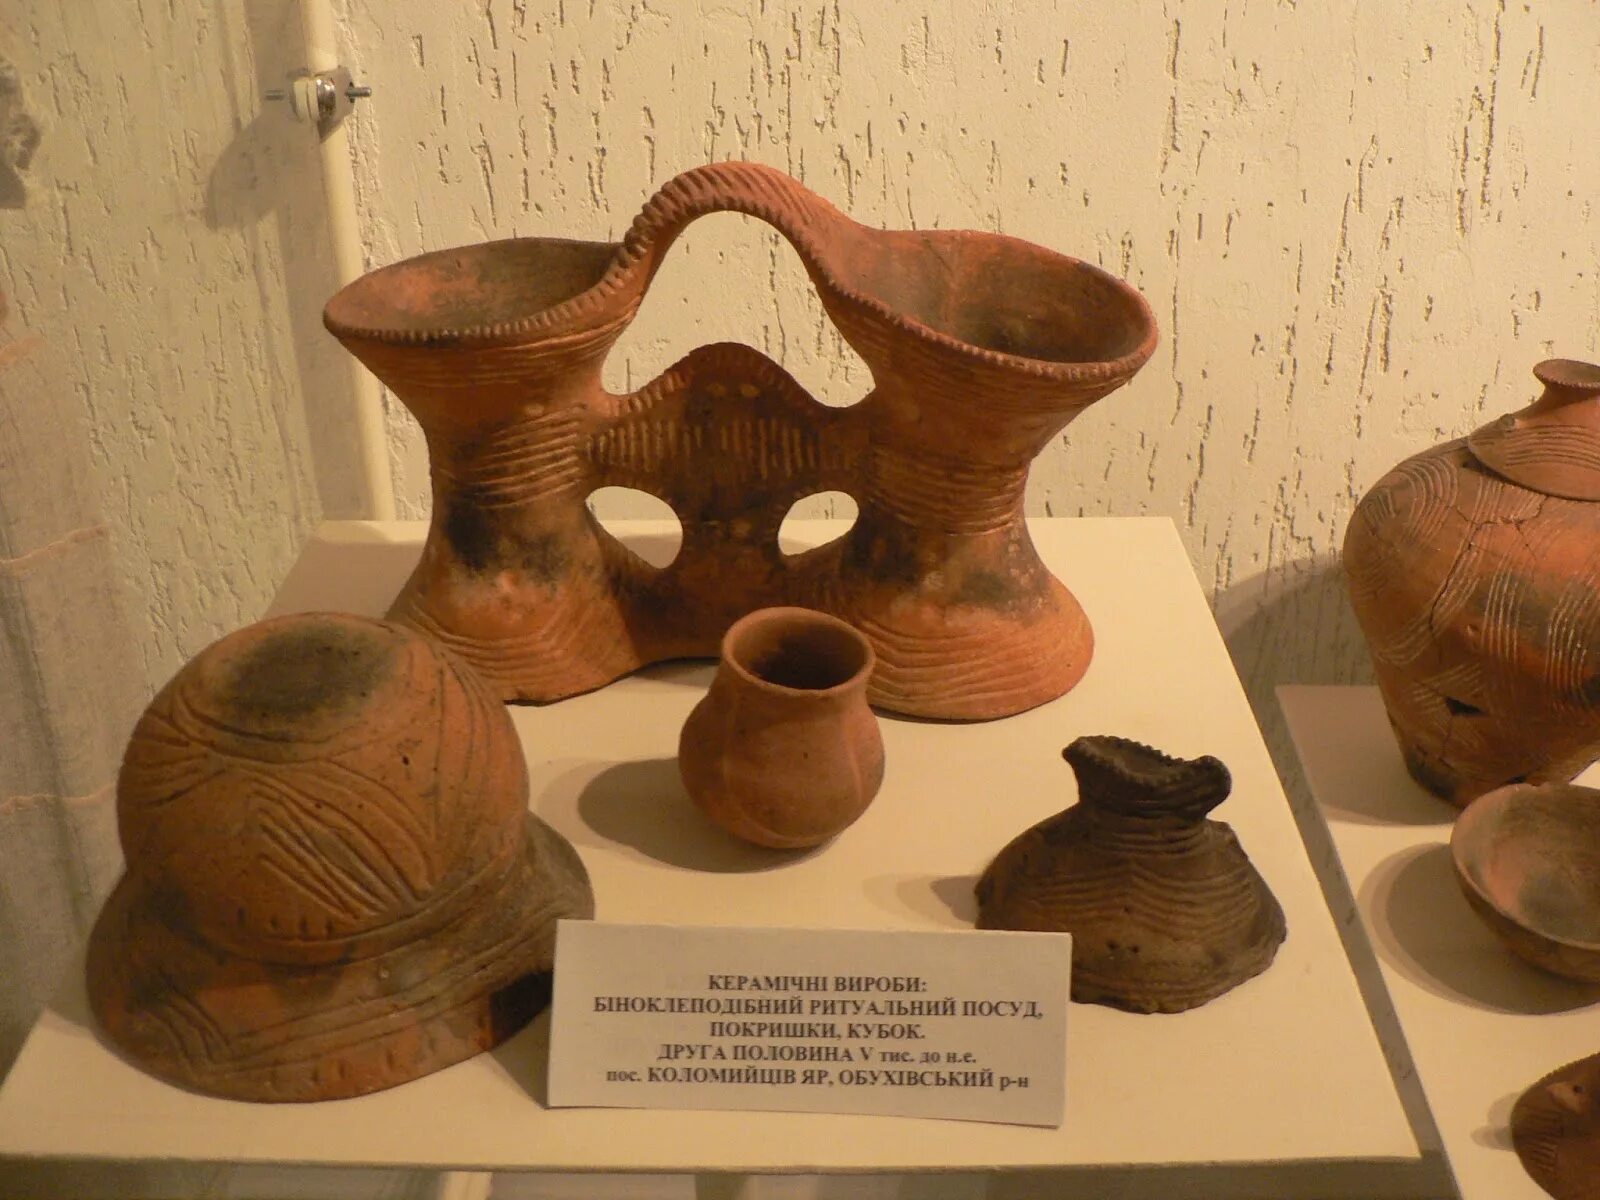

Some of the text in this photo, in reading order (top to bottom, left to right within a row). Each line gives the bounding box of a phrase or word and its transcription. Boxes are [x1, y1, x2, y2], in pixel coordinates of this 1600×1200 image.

[708, 974, 928, 993] КЕРАМІЧНІ ВИРОБИ:
[593, 996, 1044, 1019] БІНОКЛЕПОДІБНИЙ РИТУАЛЬНИЙ ПОСУД,
[710, 1021, 926, 1041] ПОКРИШКИ, КУБОК.
[656, 1043, 727, 1060] ДРУГА
[732, 1045, 854, 1062] ПОЛОВИНА
[880, 1051, 915, 1063] тис.
[919, 1051, 941, 1064] до
[945, 1051, 977, 1064] н.е.
[606, 1065, 1029, 1092] пос. КОЛОМИЙЦІВ ЯР, ОБУХІВСЬКИЙ р-н
